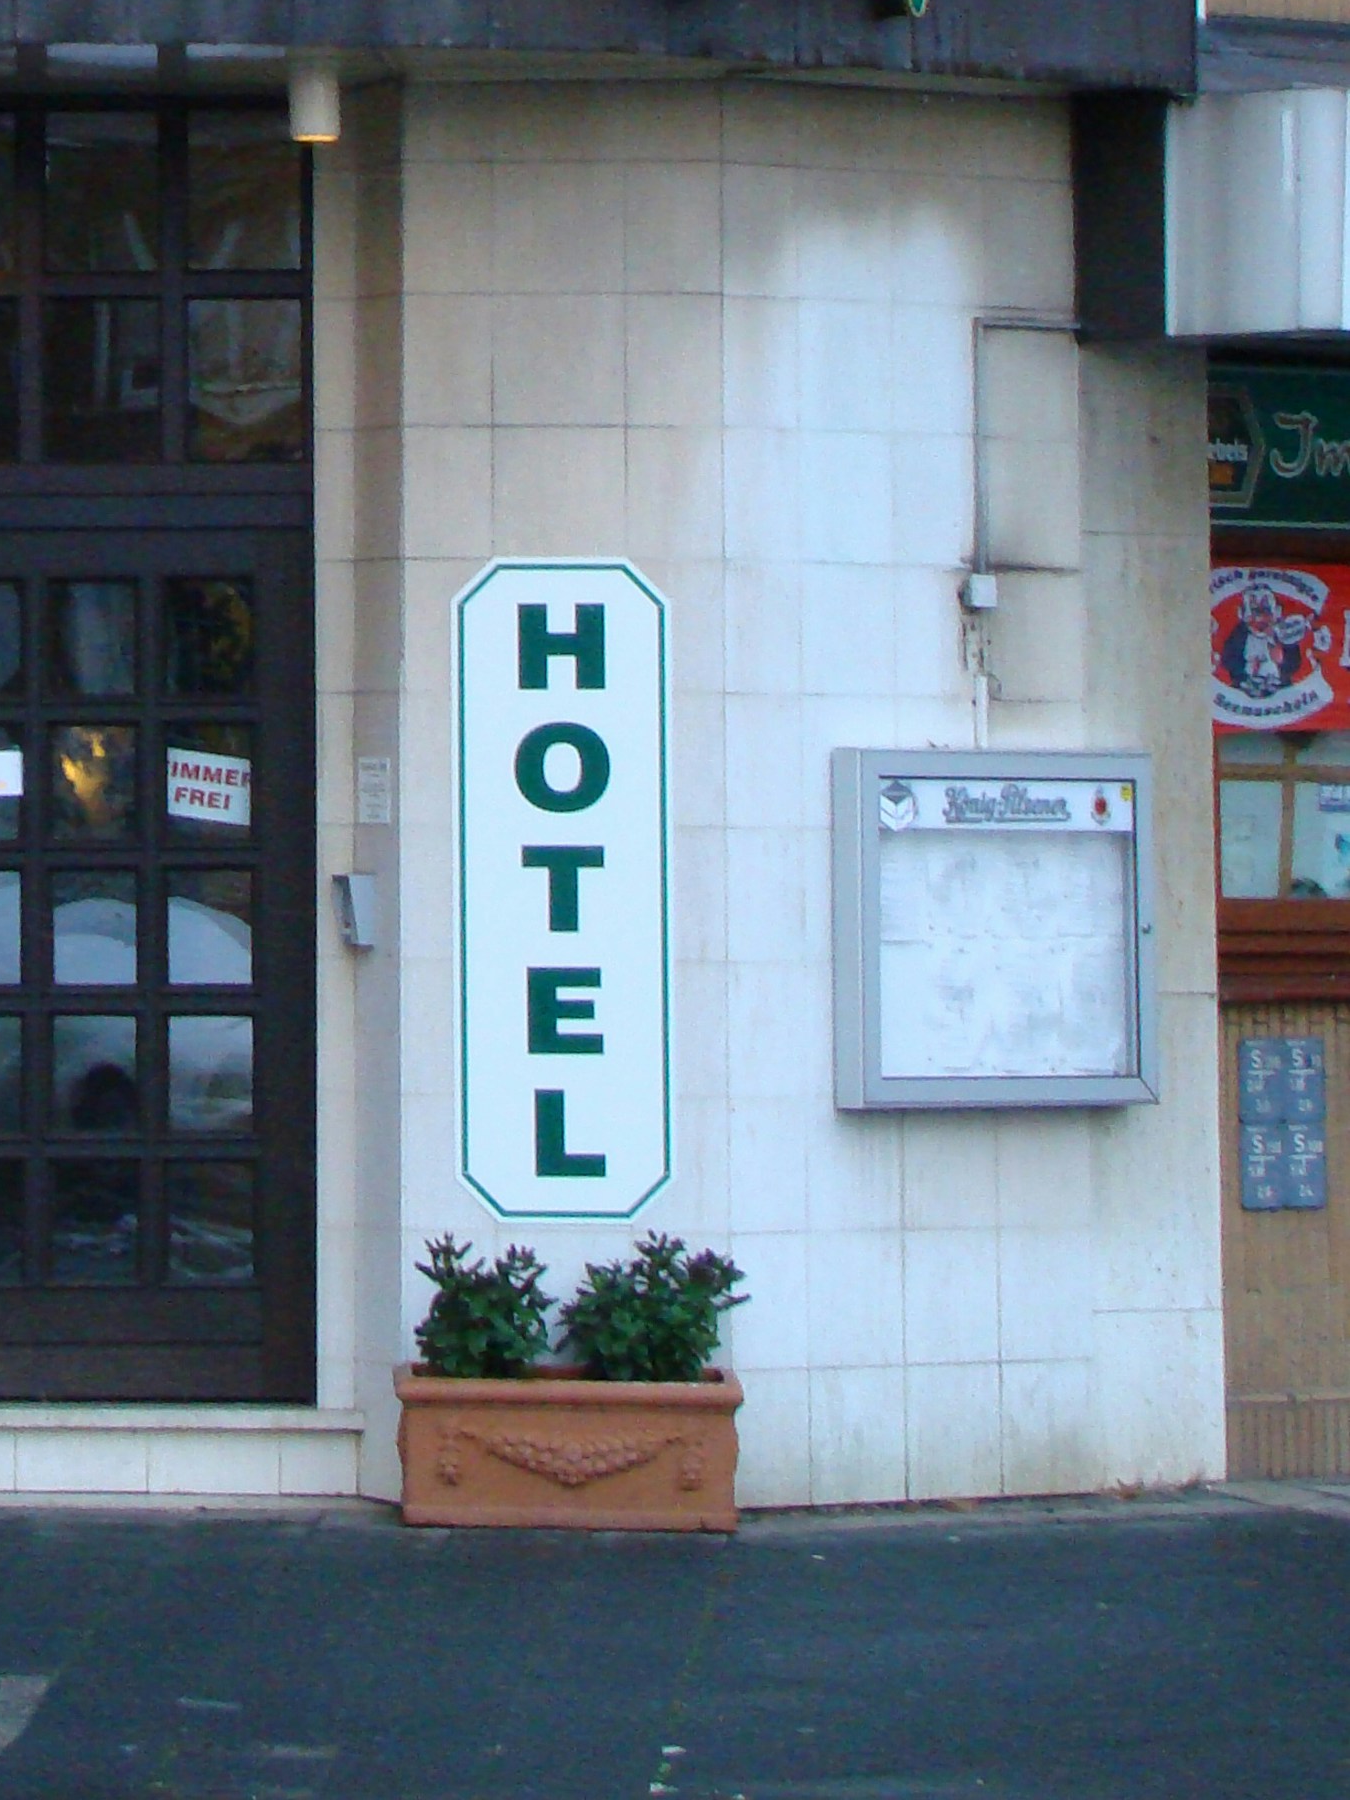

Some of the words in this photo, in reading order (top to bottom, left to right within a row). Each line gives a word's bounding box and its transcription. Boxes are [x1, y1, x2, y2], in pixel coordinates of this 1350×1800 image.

[1208, 438, 1248, 461] ebels
[167, 761, 250, 787] IMMER
[174, 786, 230, 810] FREI
[513, 603, 611, 1178] HOTEL
